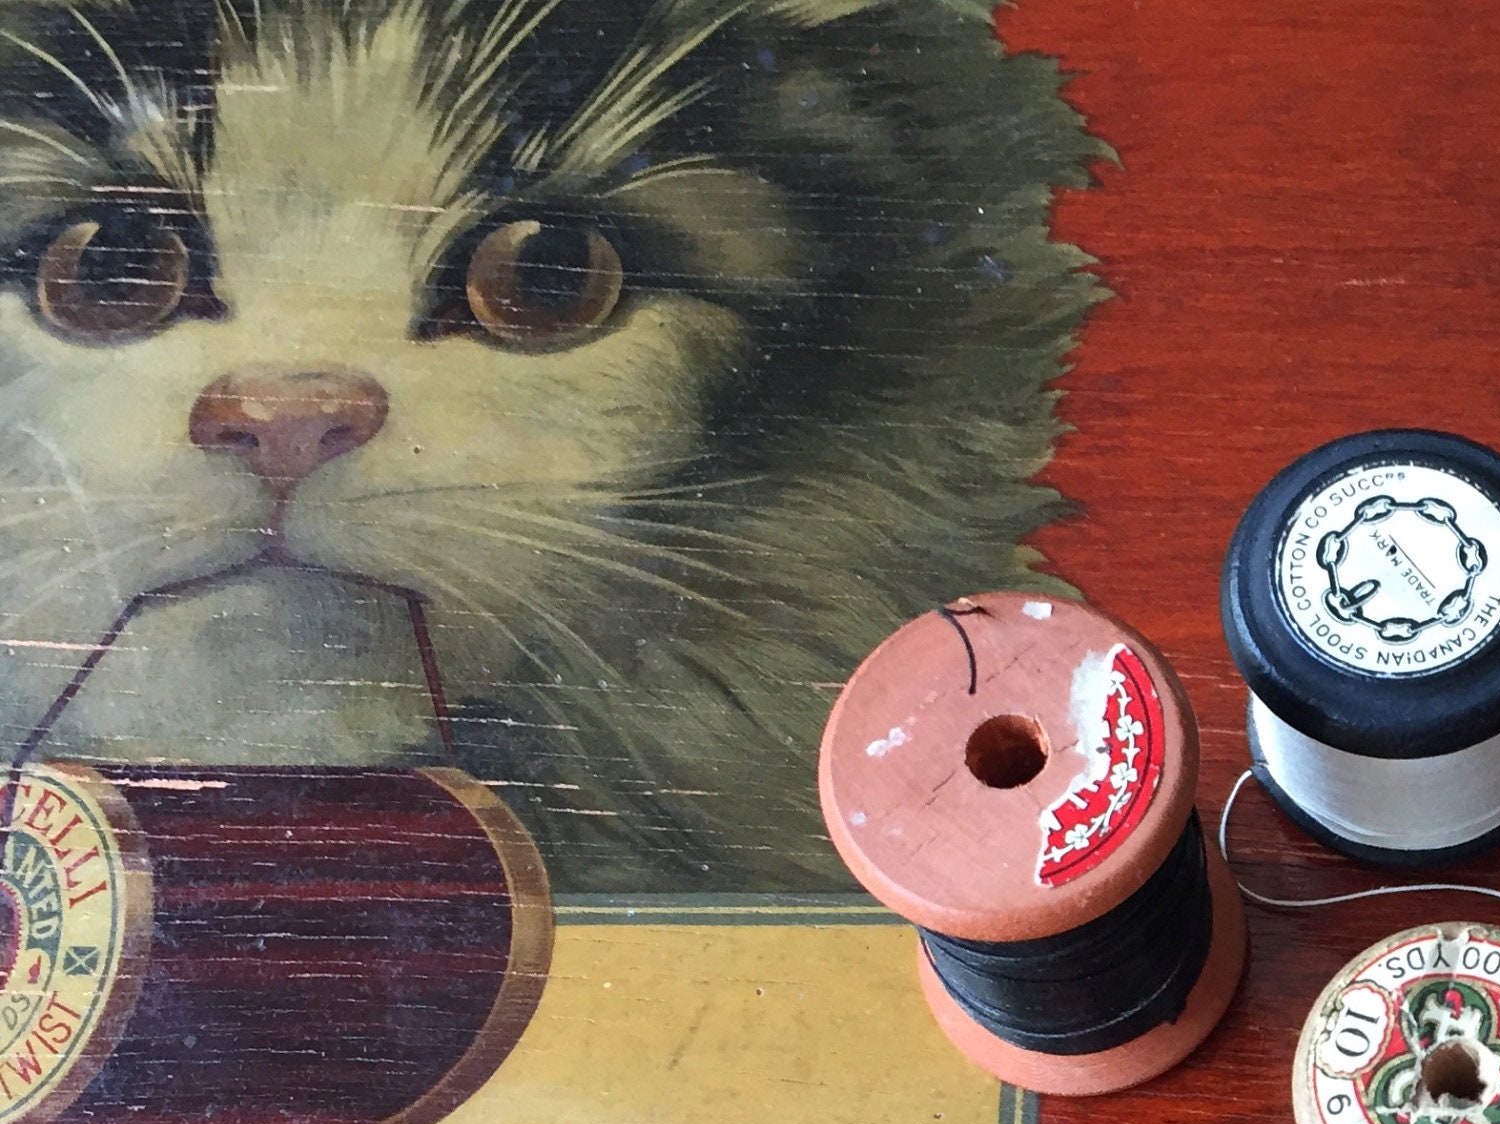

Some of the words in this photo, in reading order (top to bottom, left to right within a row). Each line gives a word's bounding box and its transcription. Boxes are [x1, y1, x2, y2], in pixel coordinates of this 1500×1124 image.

[1369, 529, 1405, 567] MARK
[1290, 532, 1312, 611] COTTON
[1400, 566, 1437, 607] TRADE
[1309, 613, 1368, 660] SPOOL
[1376, 627, 1477, 665] CANADIAN
